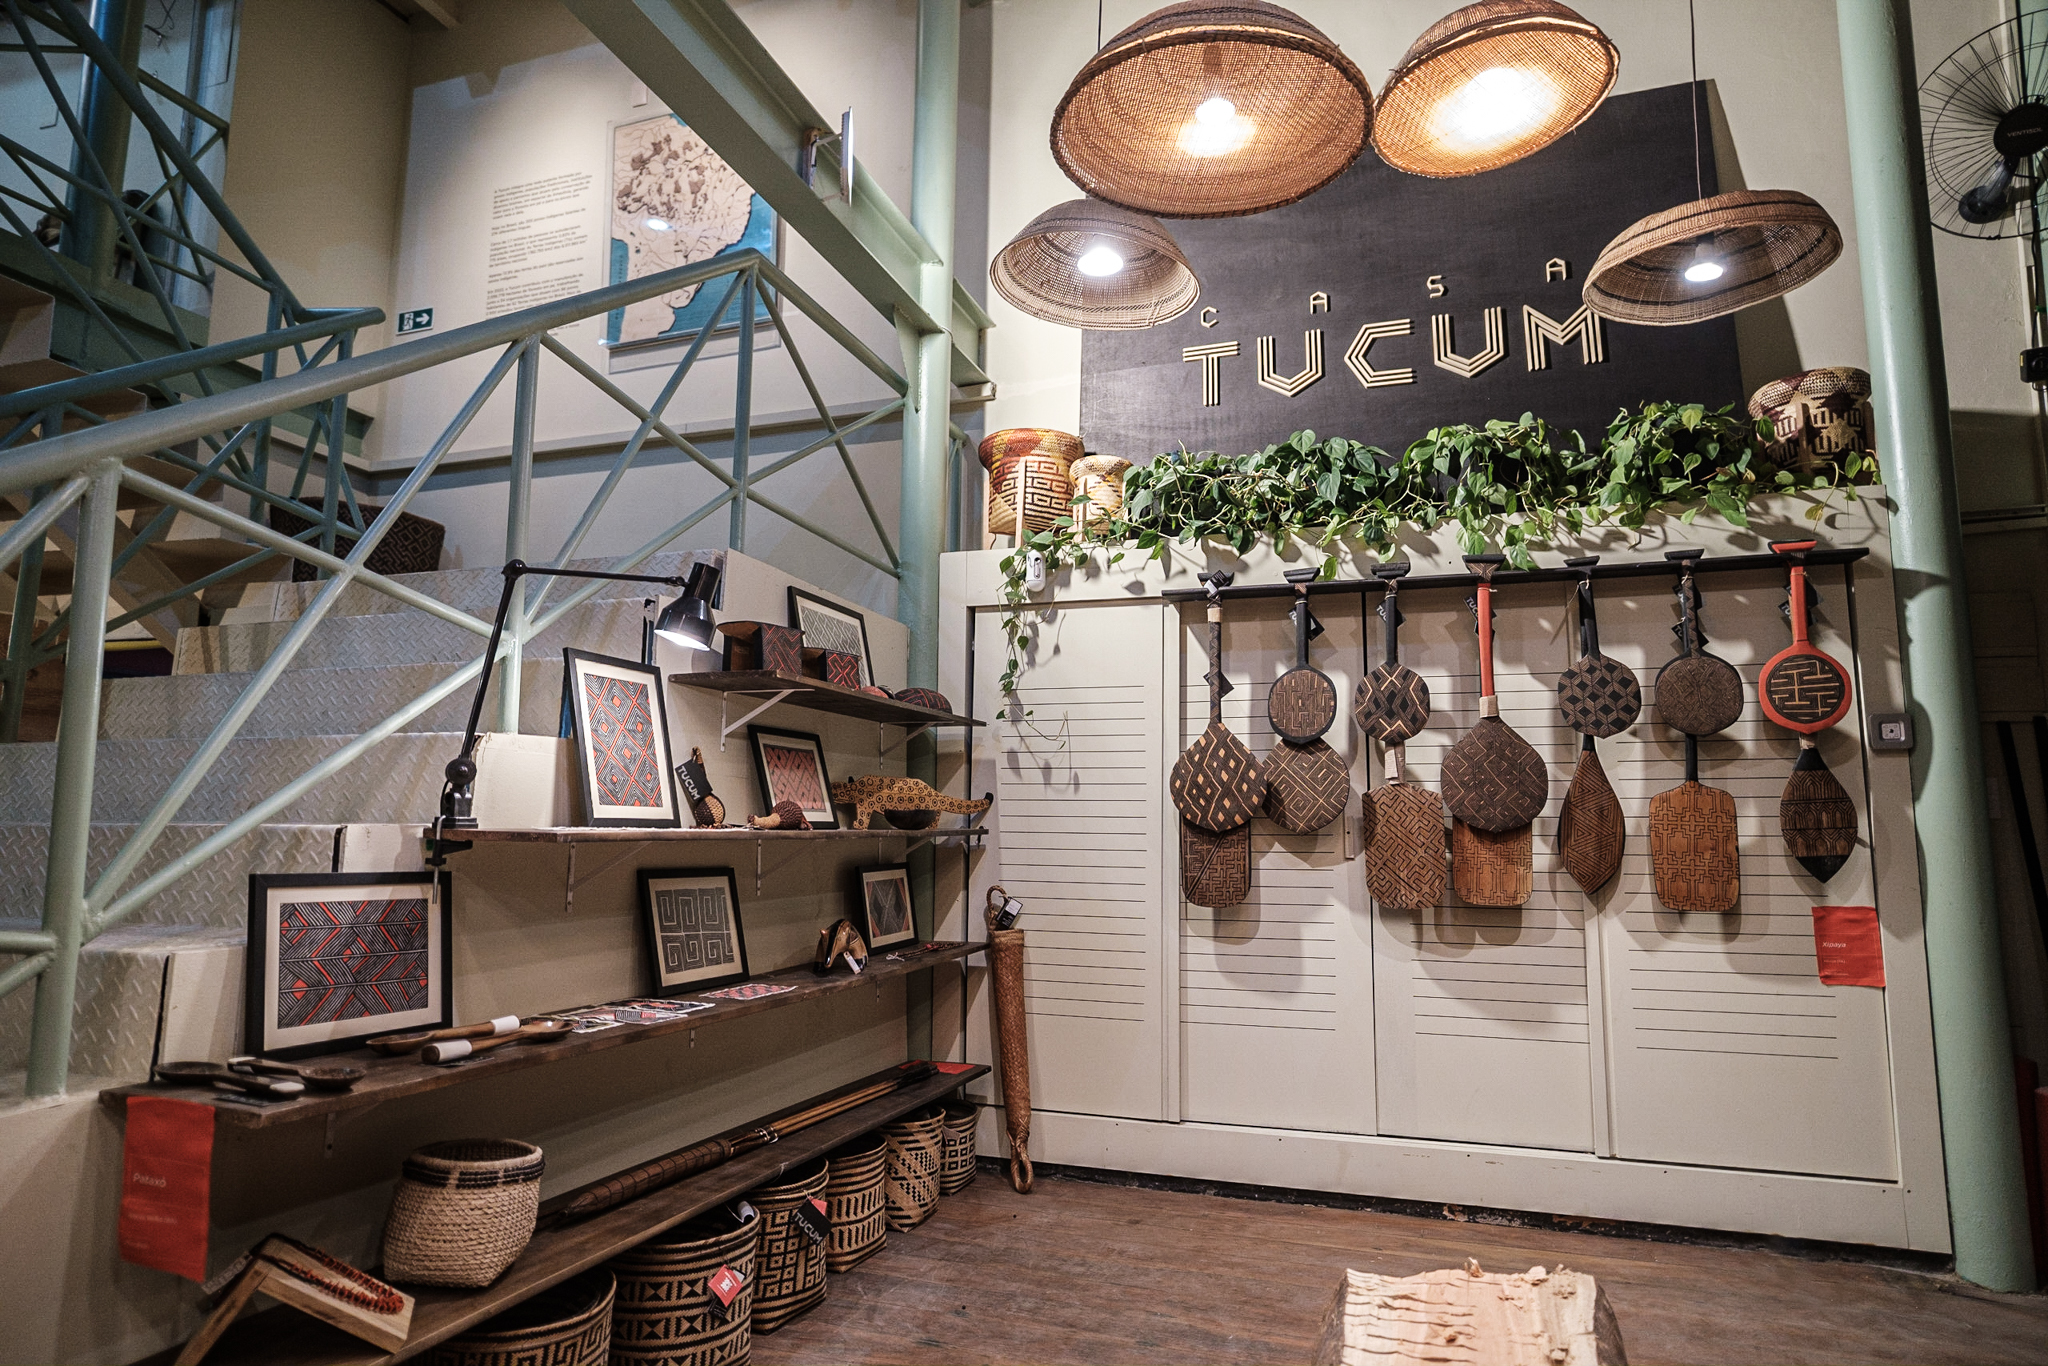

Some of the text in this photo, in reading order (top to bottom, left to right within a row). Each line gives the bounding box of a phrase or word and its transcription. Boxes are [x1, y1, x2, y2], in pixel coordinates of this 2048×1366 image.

[1182, 304, 1605, 407] TUCUM
[677, 765, 701, 800] TUCUM
[794, 1211, 823, 1244] TUCUM
